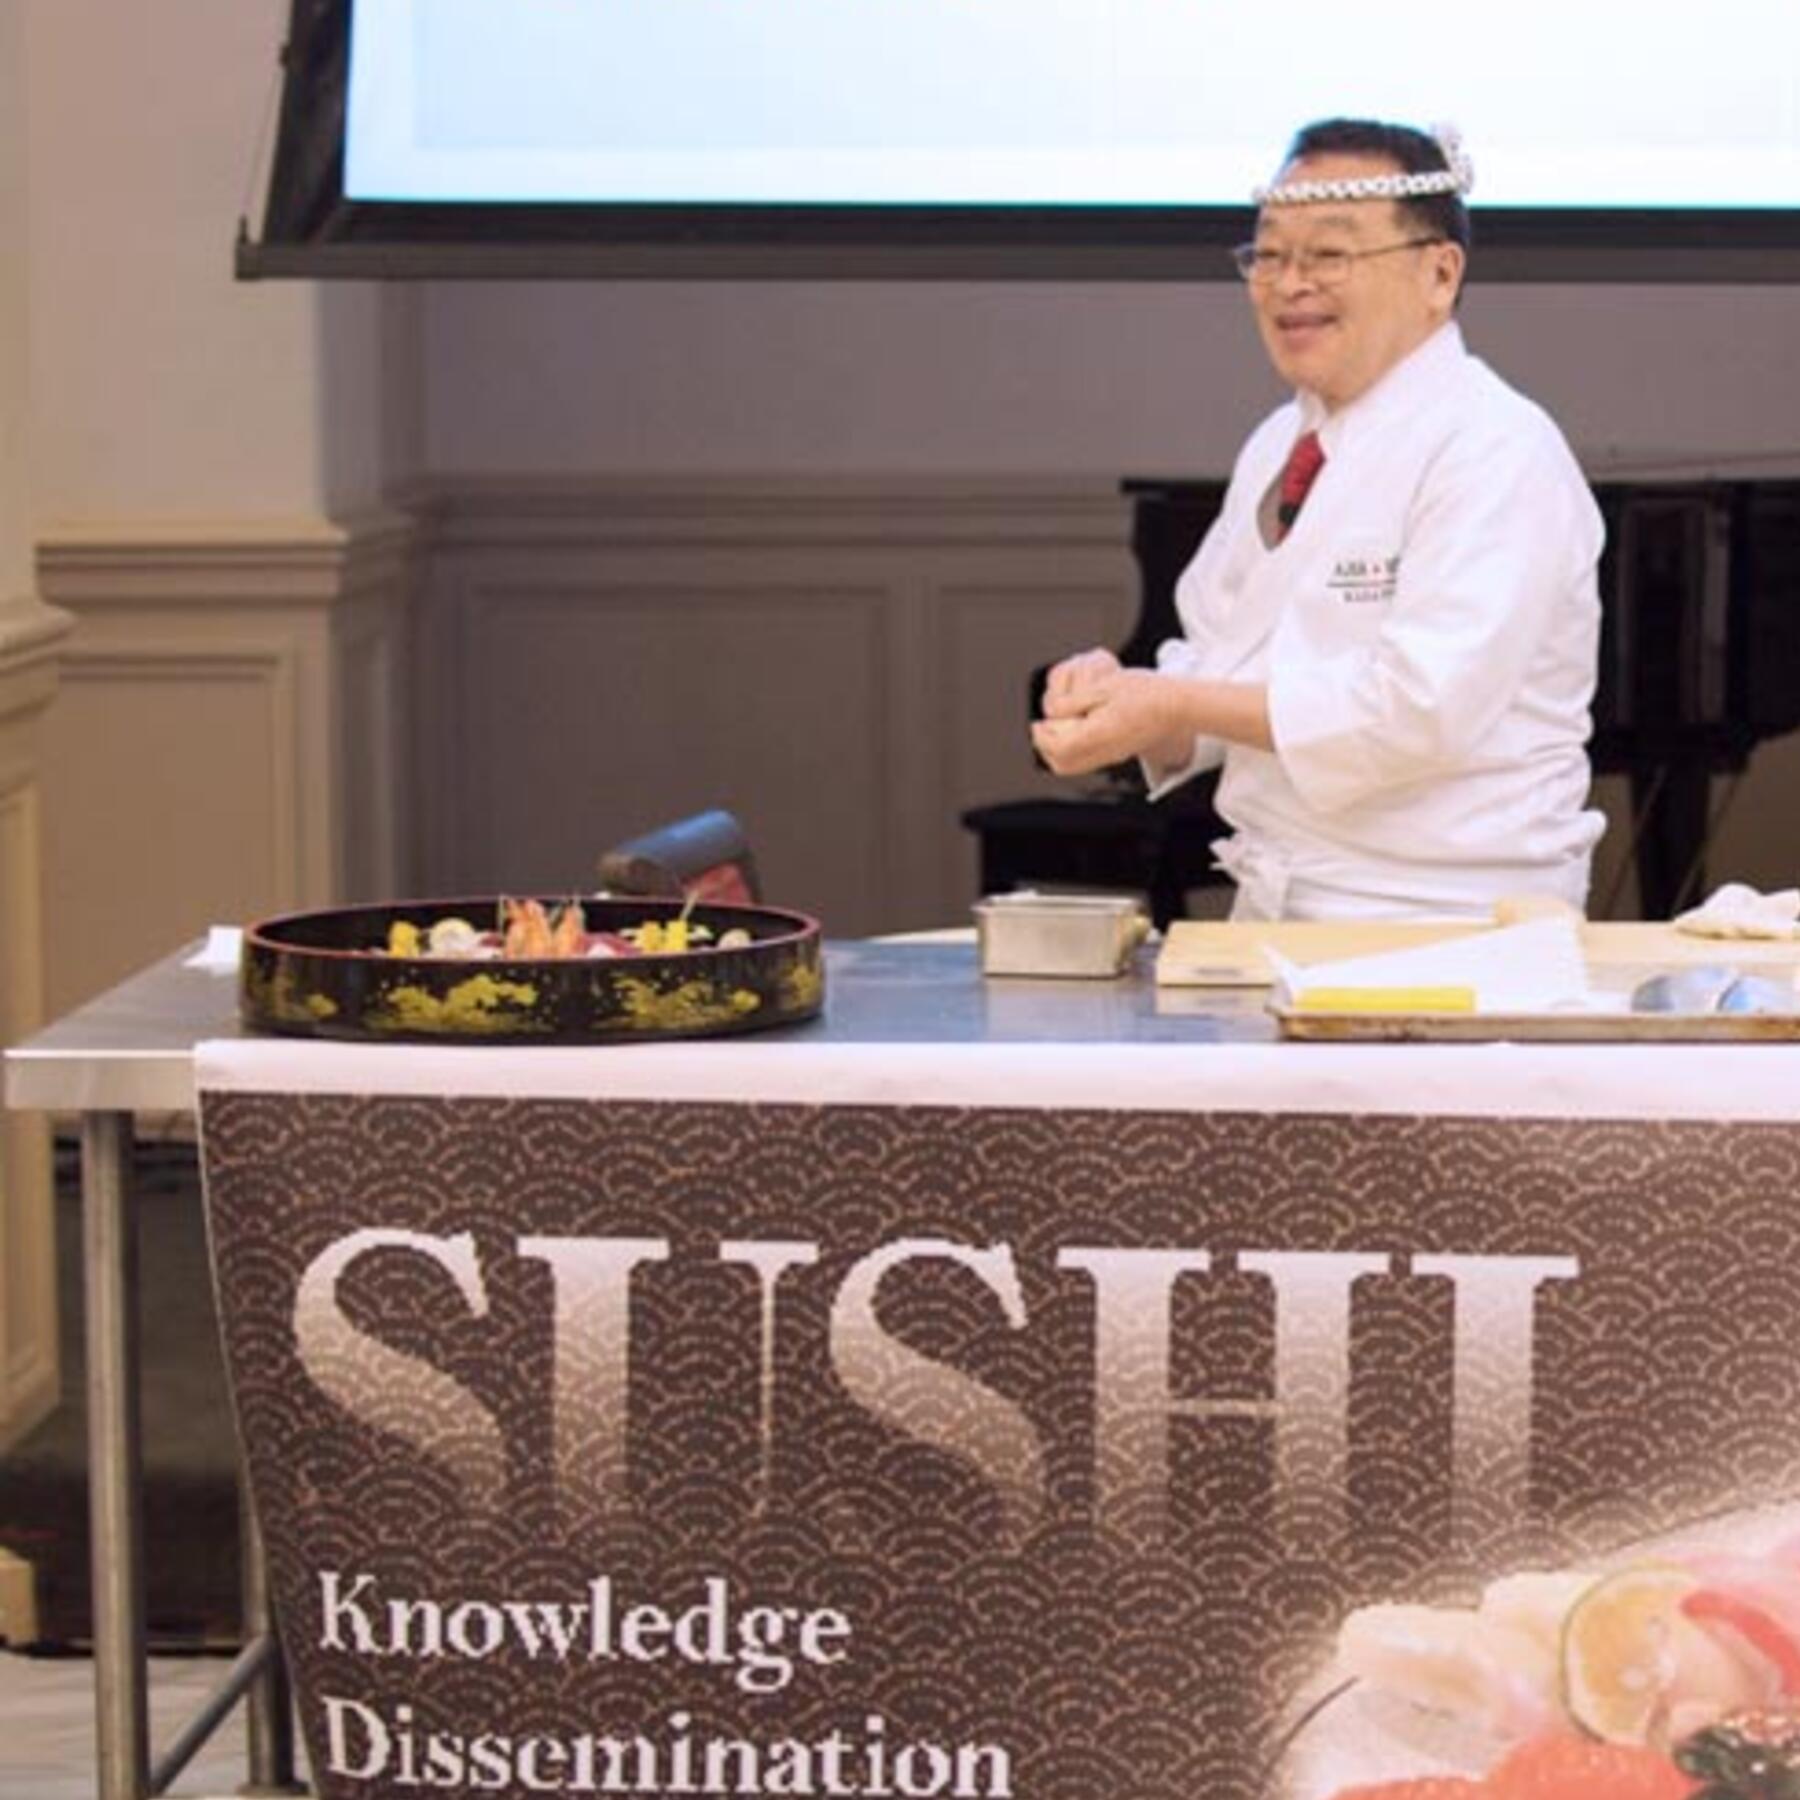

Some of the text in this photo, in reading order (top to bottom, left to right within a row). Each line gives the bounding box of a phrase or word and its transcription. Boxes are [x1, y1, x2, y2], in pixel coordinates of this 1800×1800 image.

[293, 1226, 1580, 1538] SUSHI
[318, 1570, 851, 1693] Knowledge
[321, 1695, 1014, 1798] Dissemination
